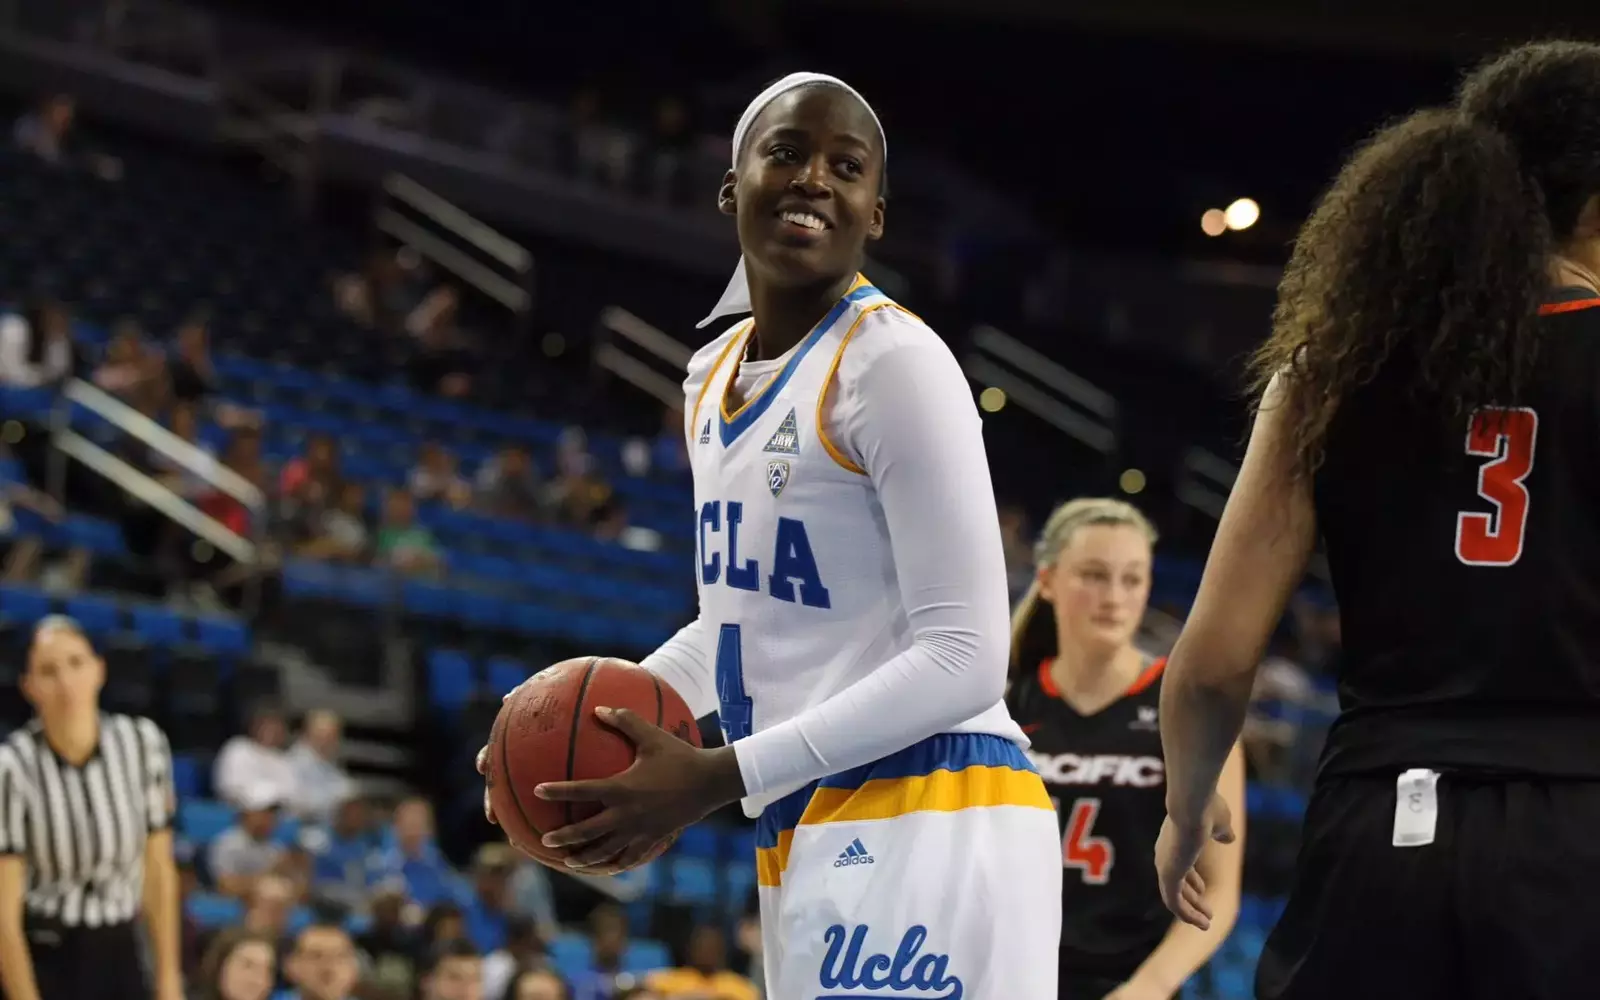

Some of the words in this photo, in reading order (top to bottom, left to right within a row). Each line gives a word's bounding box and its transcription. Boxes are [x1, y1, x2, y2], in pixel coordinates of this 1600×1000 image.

[771, 434, 795, 447] JRW
[1455, 405, 1538, 567] 3
[695, 500, 831, 609] CLA
[715, 623, 753, 745] 4
[1030, 751, 1164, 788] ACIFIC
[833, 854, 875, 868] adidas
[1051, 797, 1115, 886] 4
[819, 923, 963, 995] Ucla
